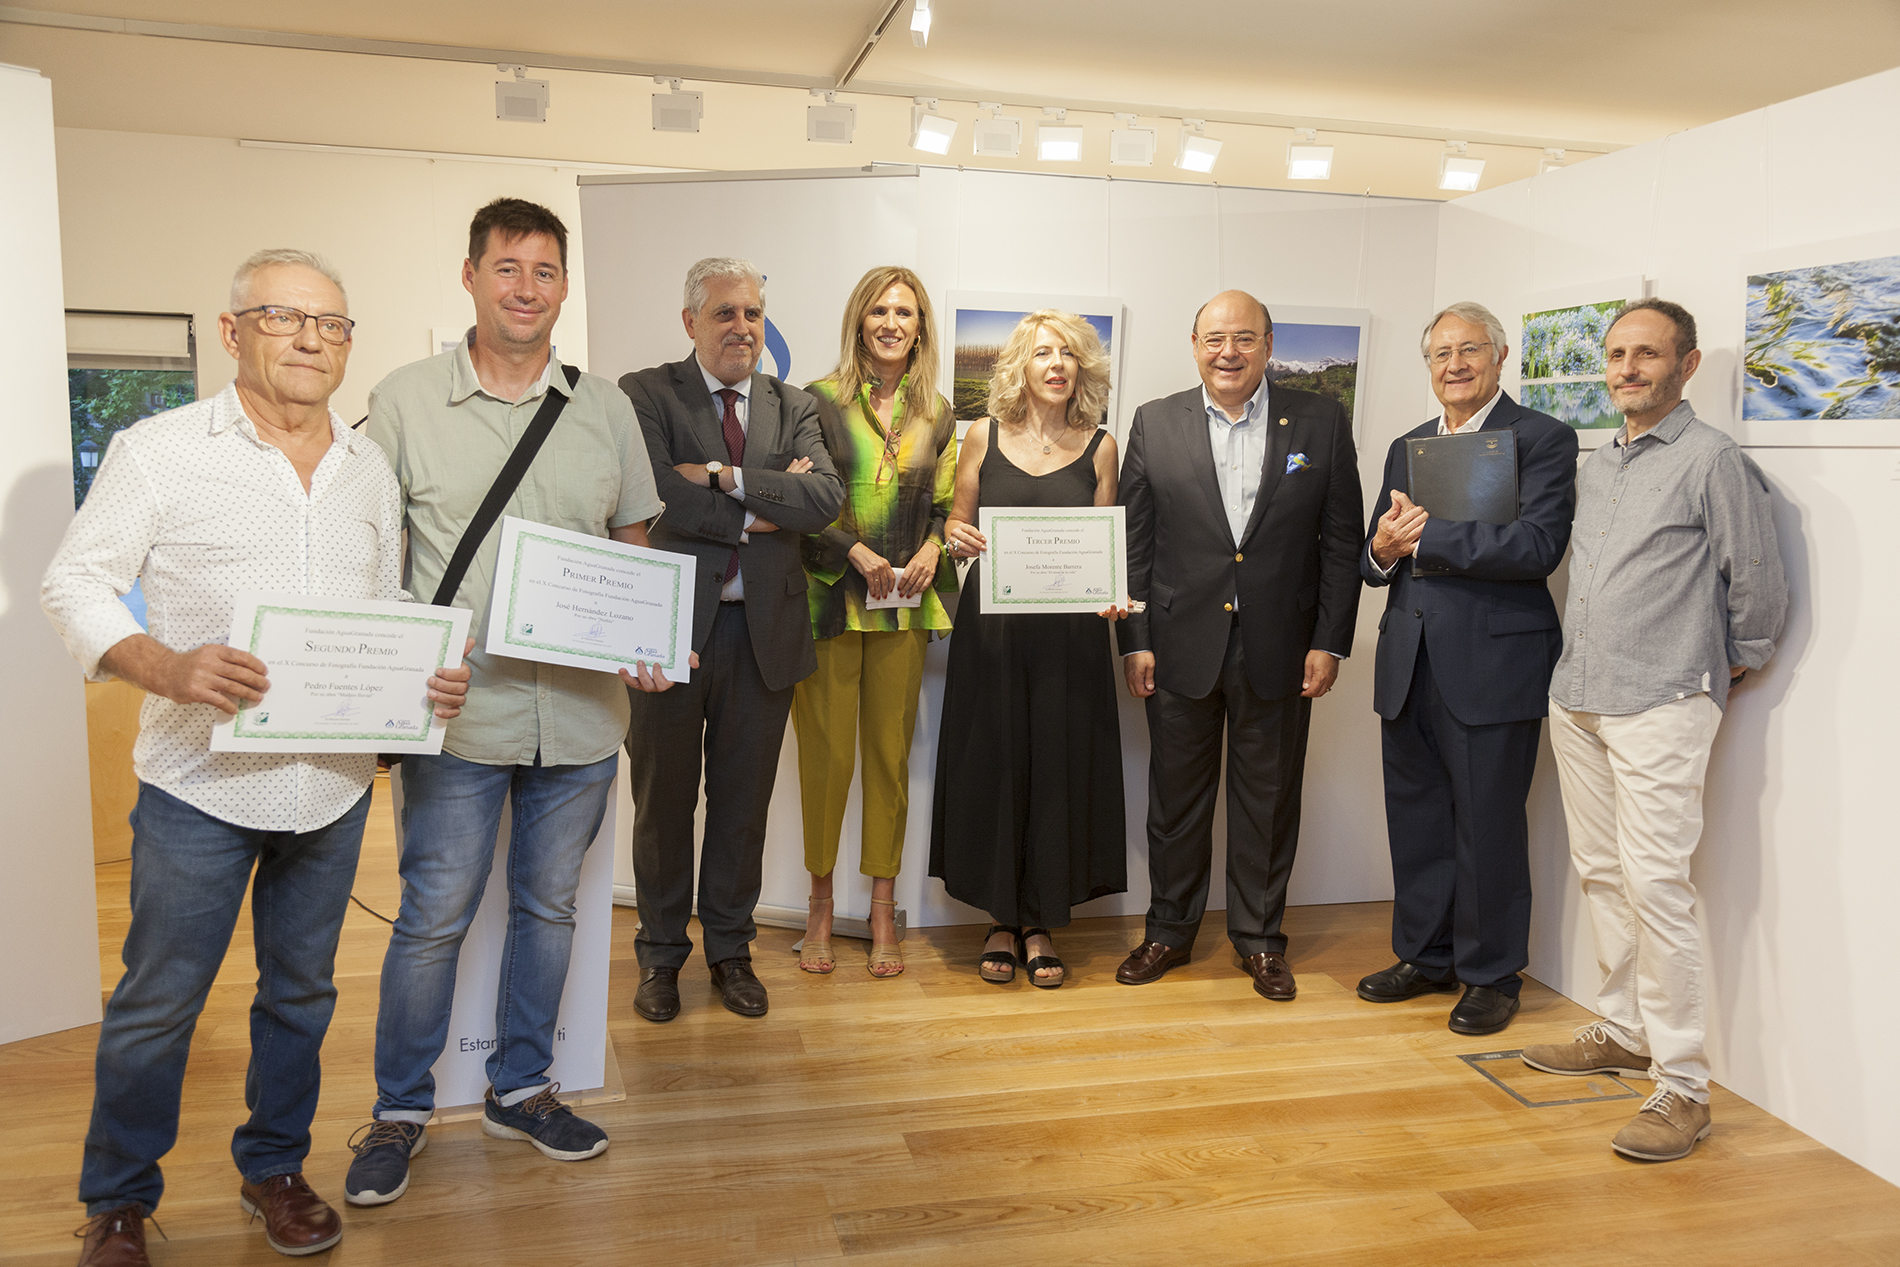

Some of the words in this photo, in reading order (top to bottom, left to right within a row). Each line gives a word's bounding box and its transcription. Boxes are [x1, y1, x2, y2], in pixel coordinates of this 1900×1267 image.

[1026, 536, 1052, 544] TERCER
[1054, 536, 1080, 544] PREMIO
[563, 567, 596, 582] PRIMER
[600, 574, 634, 590] PREMIO
[548, 582, 572, 590] Concurso
[556, 602, 570, 610] José
[572, 604, 608, 616] Hernández
[610, 612, 634, 621] Lozano
[304, 640, 356, 654] SEGUNDO
[358, 643, 398, 656] PREMIO
[360, 684, 384, 692] López
